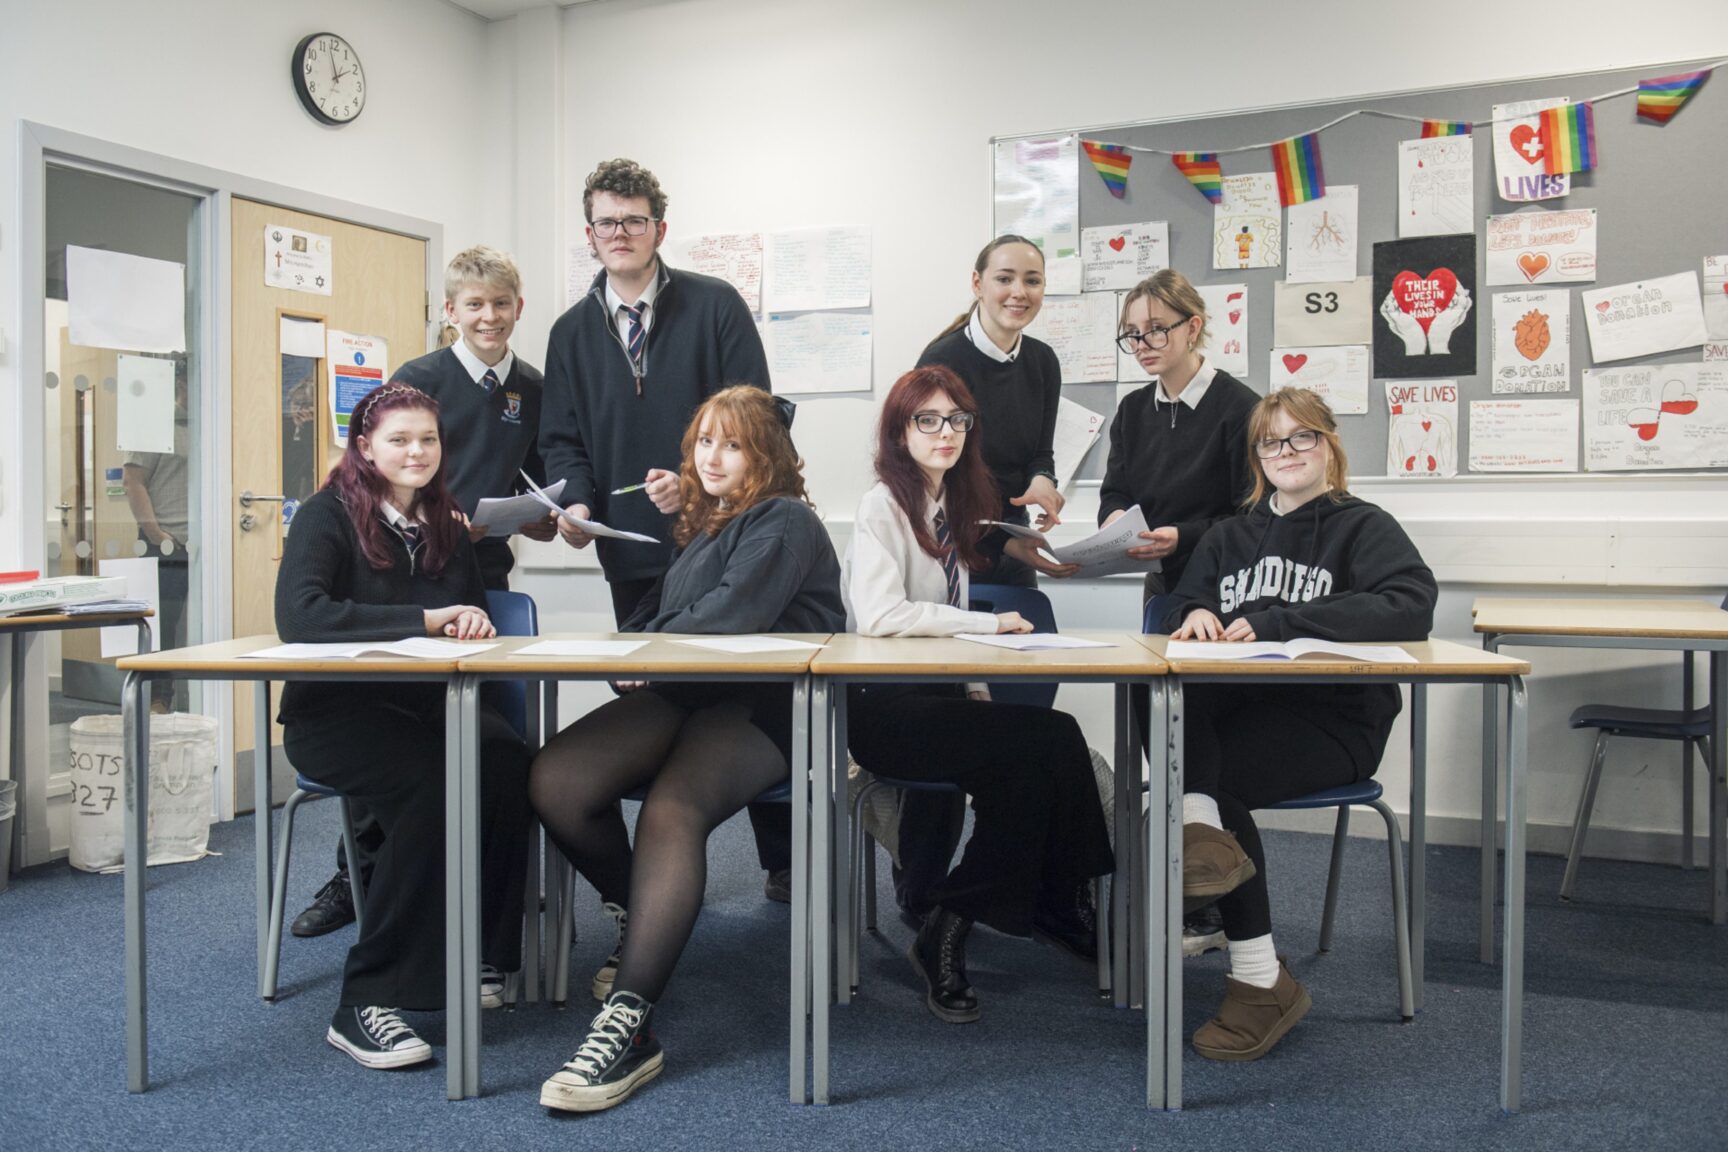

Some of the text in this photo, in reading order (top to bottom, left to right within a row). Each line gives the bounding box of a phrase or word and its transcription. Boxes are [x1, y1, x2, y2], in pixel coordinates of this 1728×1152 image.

[319, 40, 326, 52] 11
[330, 38, 340, 52] 12
[308, 48, 317, 60] 10
[344, 49, 348, 60] 1
[305, 63, 312, 75] 9
[352, 63, 358, 75] 2
[309, 80, 316, 93] 8
[356, 81, 362, 92] 3
[319, 97, 326, 109] 7
[352, 97, 359, 107] 4
[332, 106, 338, 117] 6
[344, 105, 350, 117] 5
[1503, 172, 1565, 200] LIVES
[1405, 279, 1440, 292] THEIR
[1404, 290, 1444, 302] LIVES IN
[1305, 291, 1339, 314] S3
[1413, 300, 1435, 309] YOUR
[1409, 307, 1442, 319] HANDS
[1622, 371, 1652, 387] CAN
[1388, 385, 1457, 404] SAVE LIVES
[1599, 386, 1653, 405] SAVE A
[1597, 408, 1628, 426] LIFE
